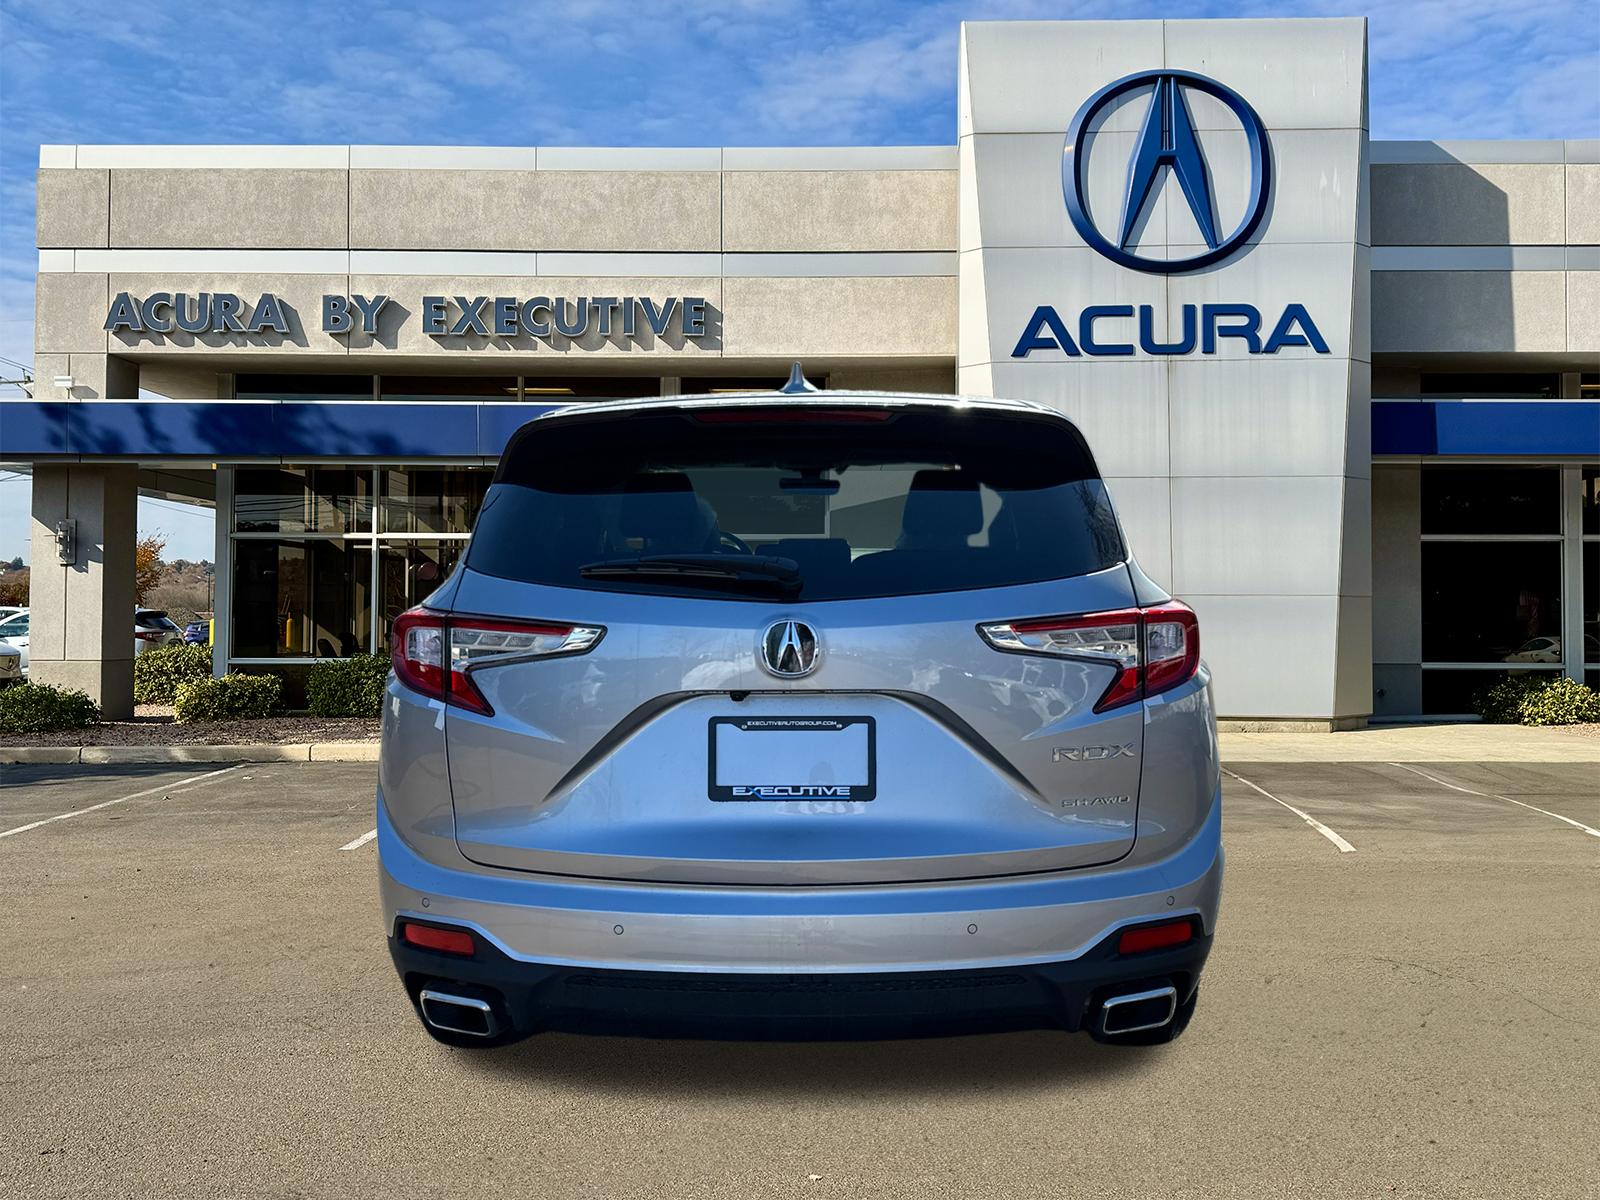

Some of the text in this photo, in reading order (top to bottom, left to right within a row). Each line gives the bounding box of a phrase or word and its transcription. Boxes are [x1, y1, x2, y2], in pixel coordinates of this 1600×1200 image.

[103, 292, 706, 337] ACURA BY EXECUTIVE
[1010, 303, 1332, 357] ACURA
[1052, 743, 1135, 762] RDX
[733, 786, 850, 797] EXECUTIVE
